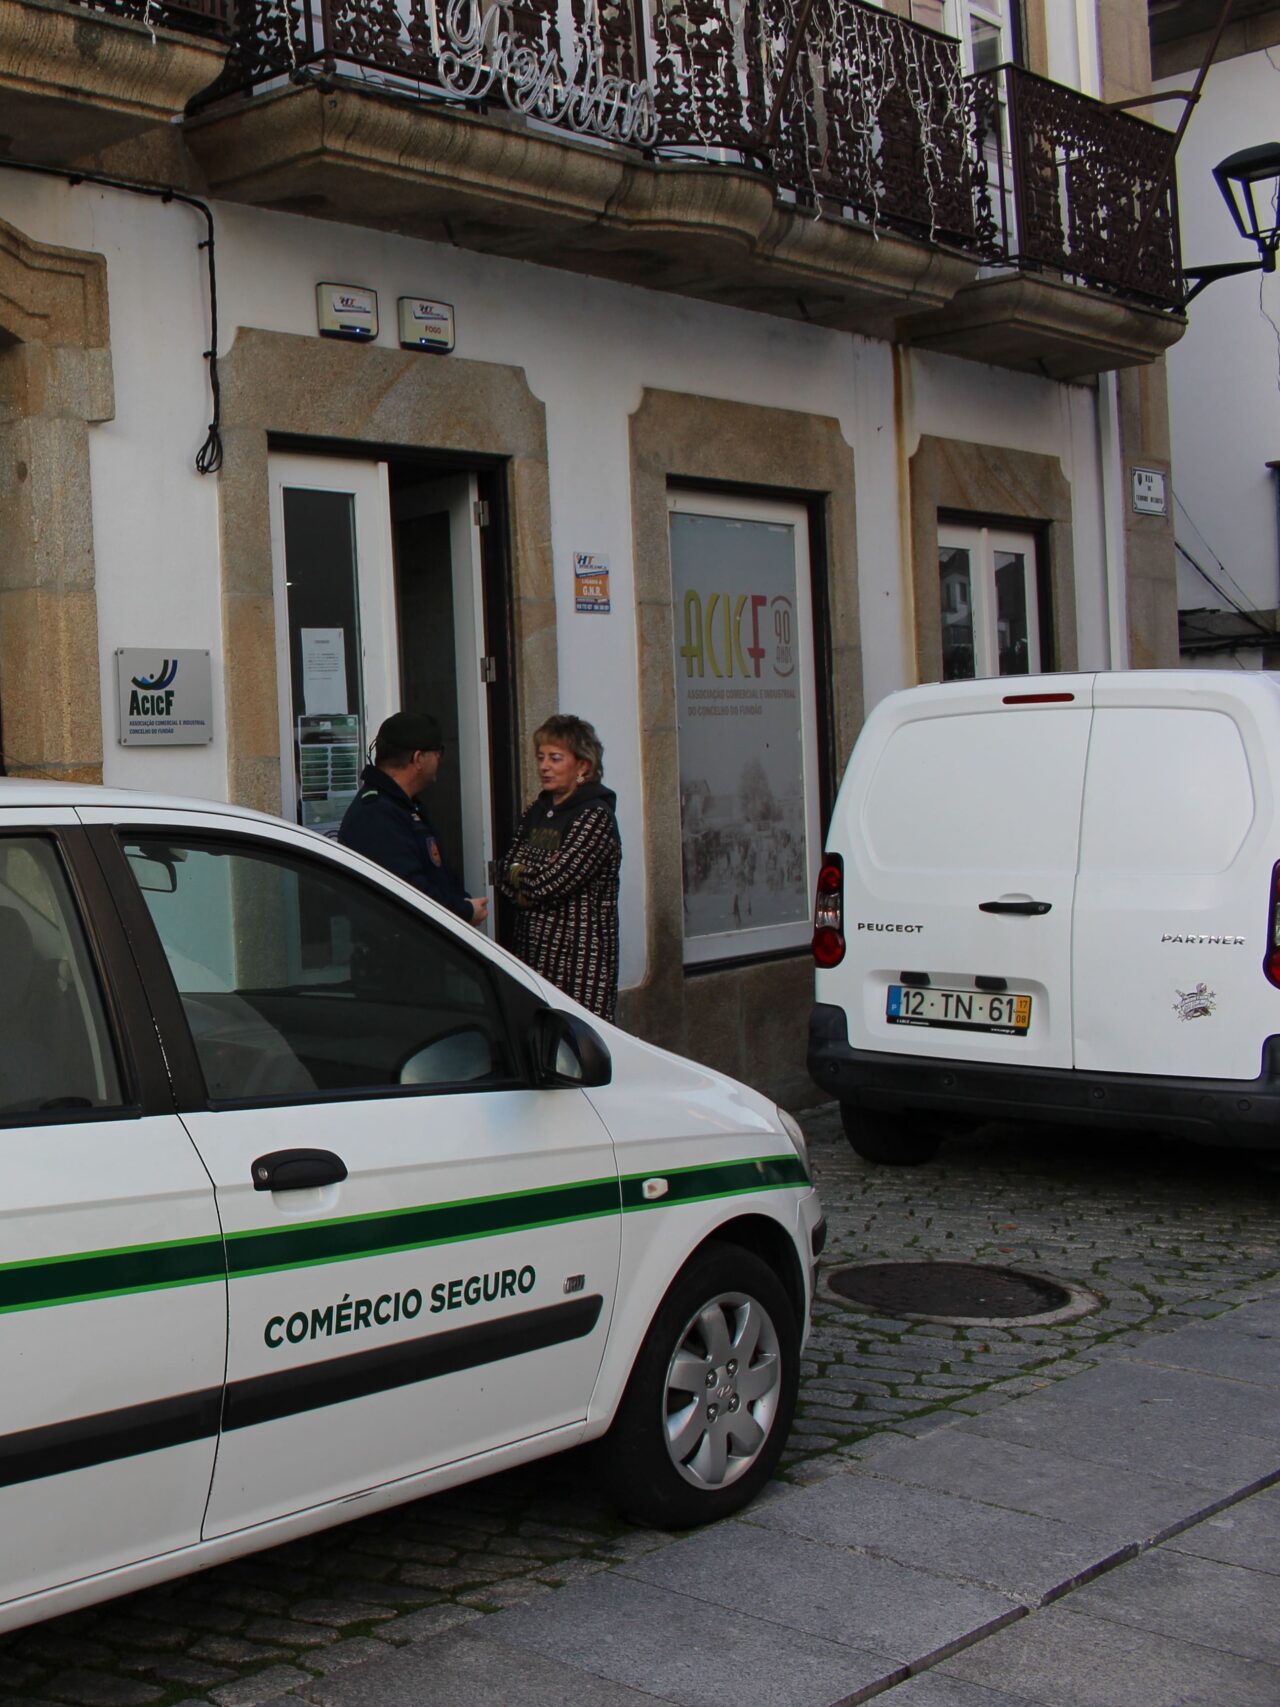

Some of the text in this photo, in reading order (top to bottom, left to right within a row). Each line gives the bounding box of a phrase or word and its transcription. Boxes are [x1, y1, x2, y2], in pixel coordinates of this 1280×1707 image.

[425, 325, 441, 335] FOGO
[680, 588, 767, 678] ACICF
[774, 610, 791, 644] 90
[776, 645, 792, 664] ANOS
[129, 690, 175, 716] ACICF
[858, 922, 924, 934] PEUGEOT
[1160, 933, 1246, 946] PARTNER
[1019, 1000, 1028, 1009] 17
[1016, 1014, 1026, 1024] 08
[264, 1265, 536, 1348] COMÉRCIO SEGURO
